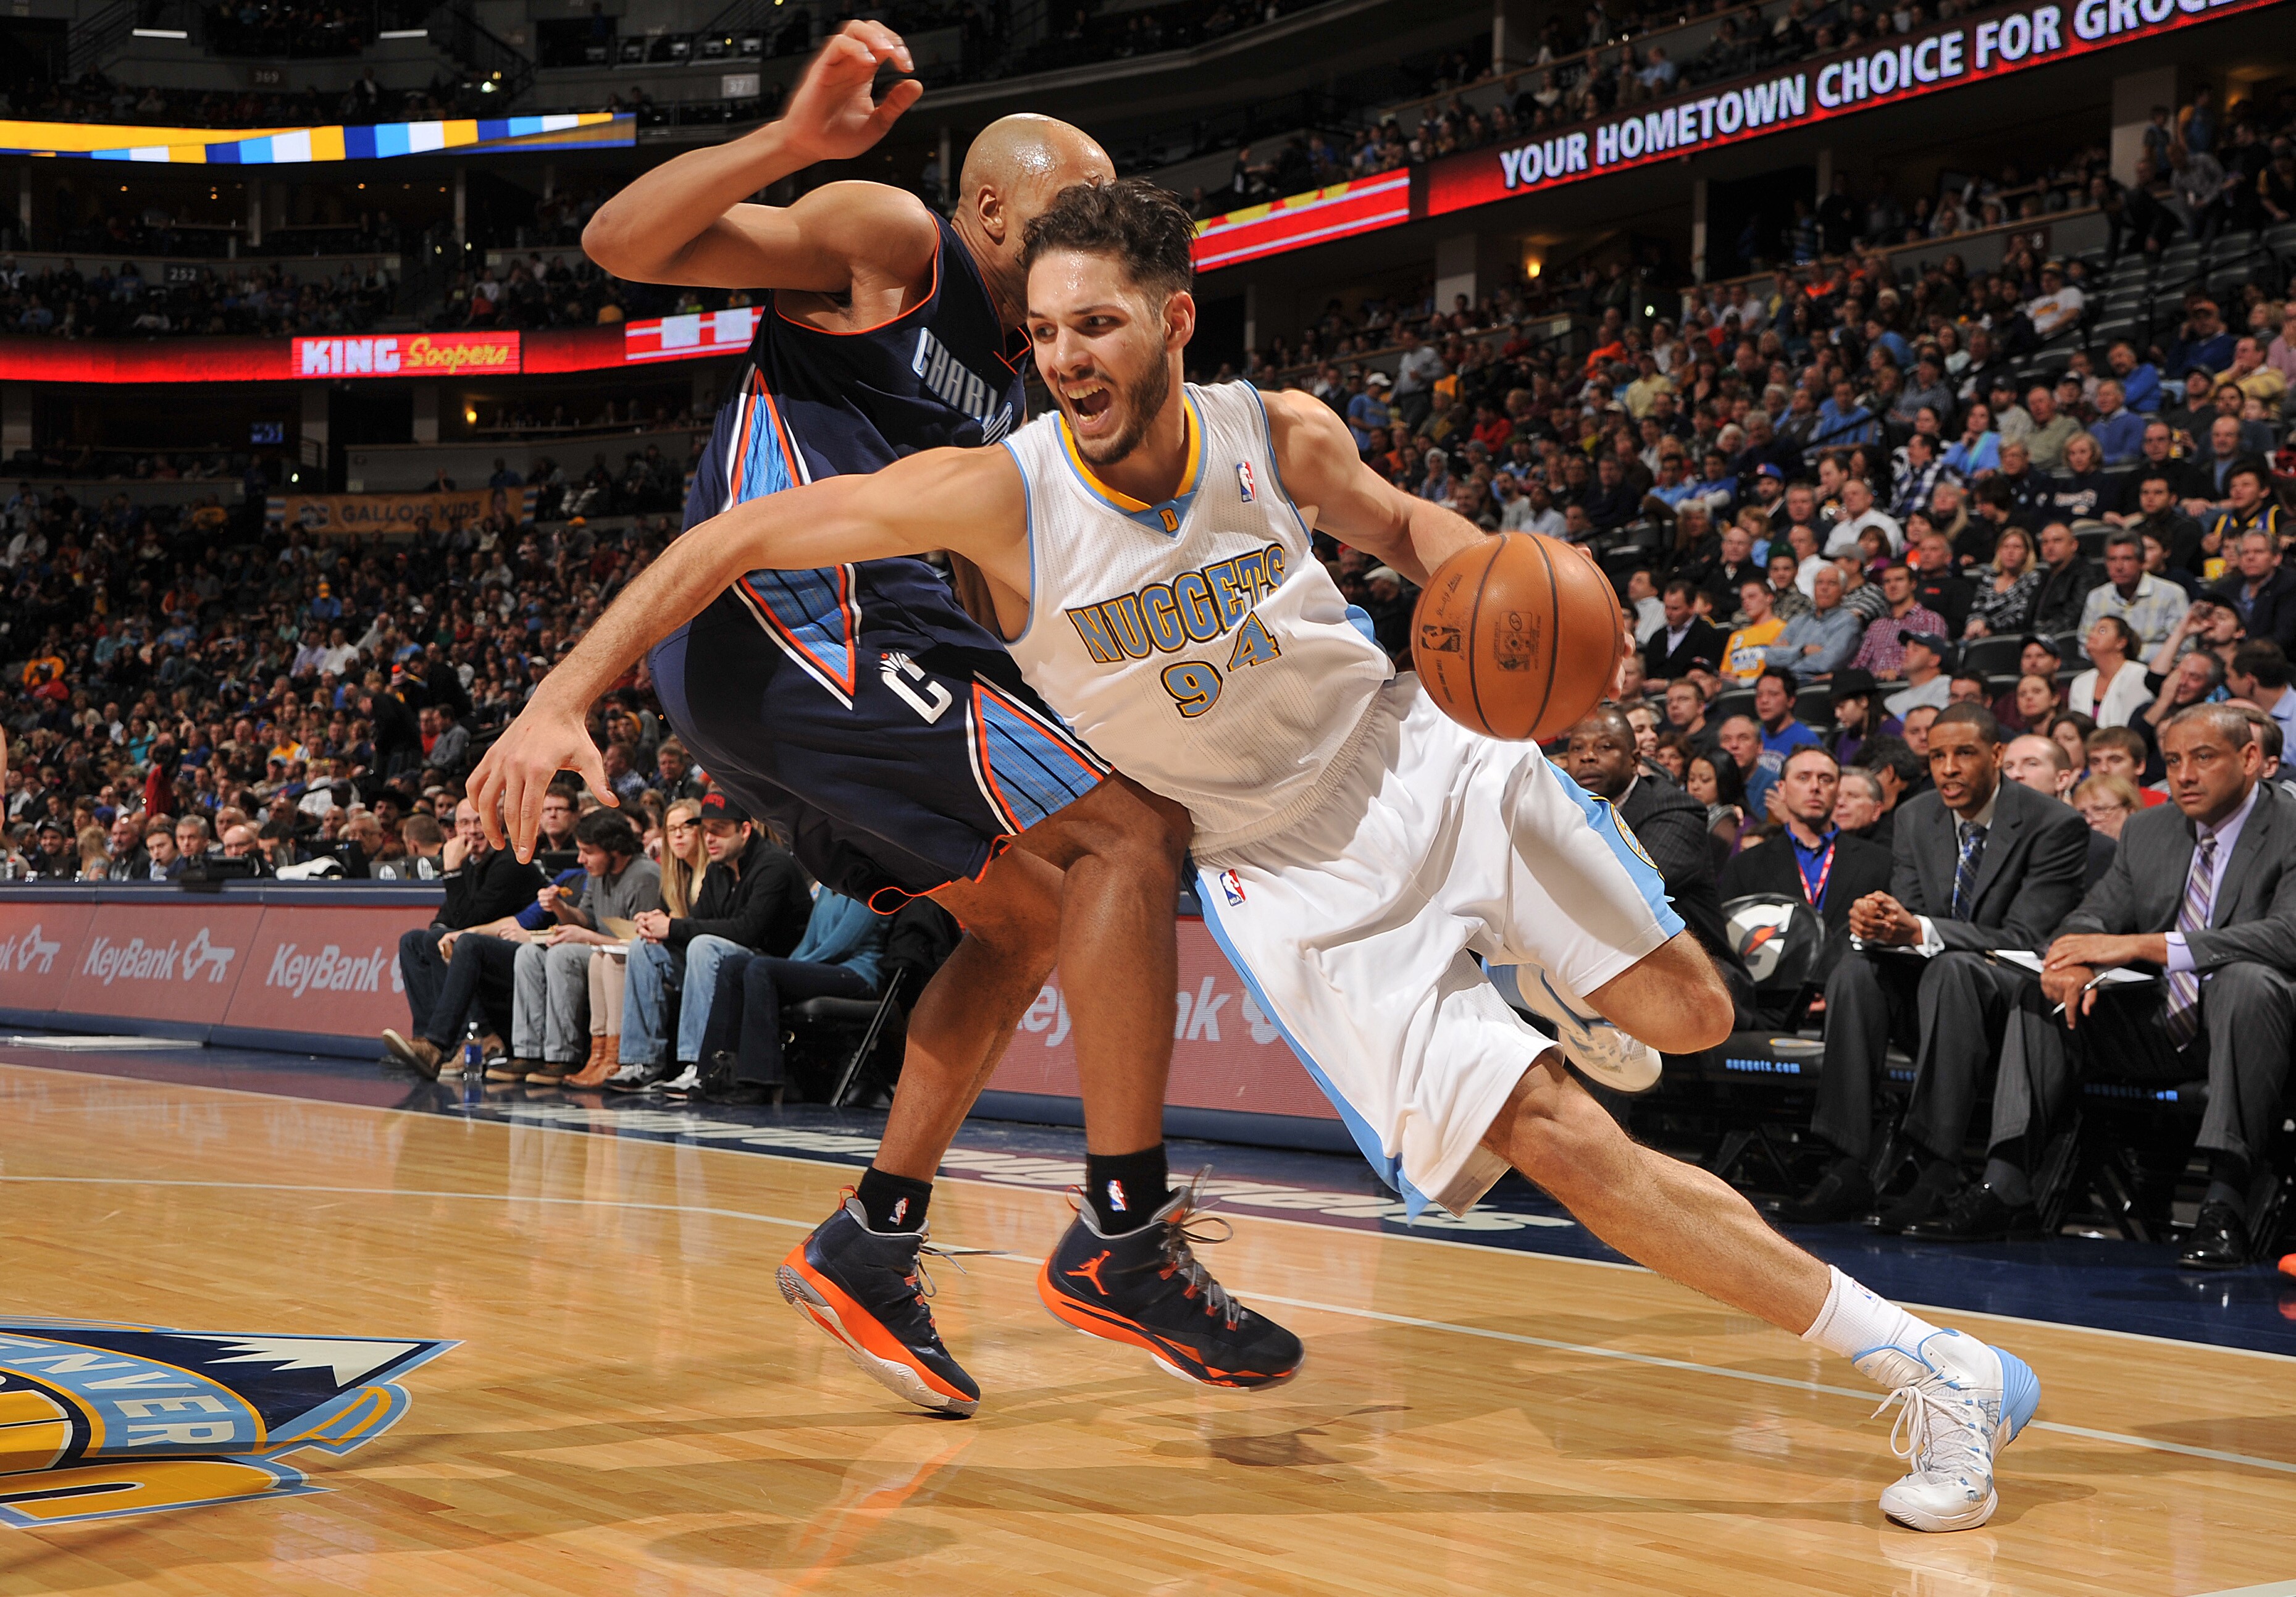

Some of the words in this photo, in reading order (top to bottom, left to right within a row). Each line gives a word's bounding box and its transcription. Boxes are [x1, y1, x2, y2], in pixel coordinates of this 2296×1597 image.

[1499, 132, 1588, 188] YOUR
[1596, 73, 1806, 166] HOMETOWN
[1817, 30, 1964, 108] CHOICE
[1975, 6, 2061, 69] FOR
[301, 338, 400, 374] KING
[406, 337, 509, 374] Soopers
[341, 503, 432, 524] GALLO'S
[439, 501, 482, 520] KIDS
[1158, 508, 1179, 533] D
[1065, 542, 1285, 664] NUGGETS
[1160, 610, 1282, 718] 94
[83, 936, 179, 986] KeyBank
[266, 943, 387, 999] KeyBank
[1725, 1058, 1801, 1074] nuggets.com
